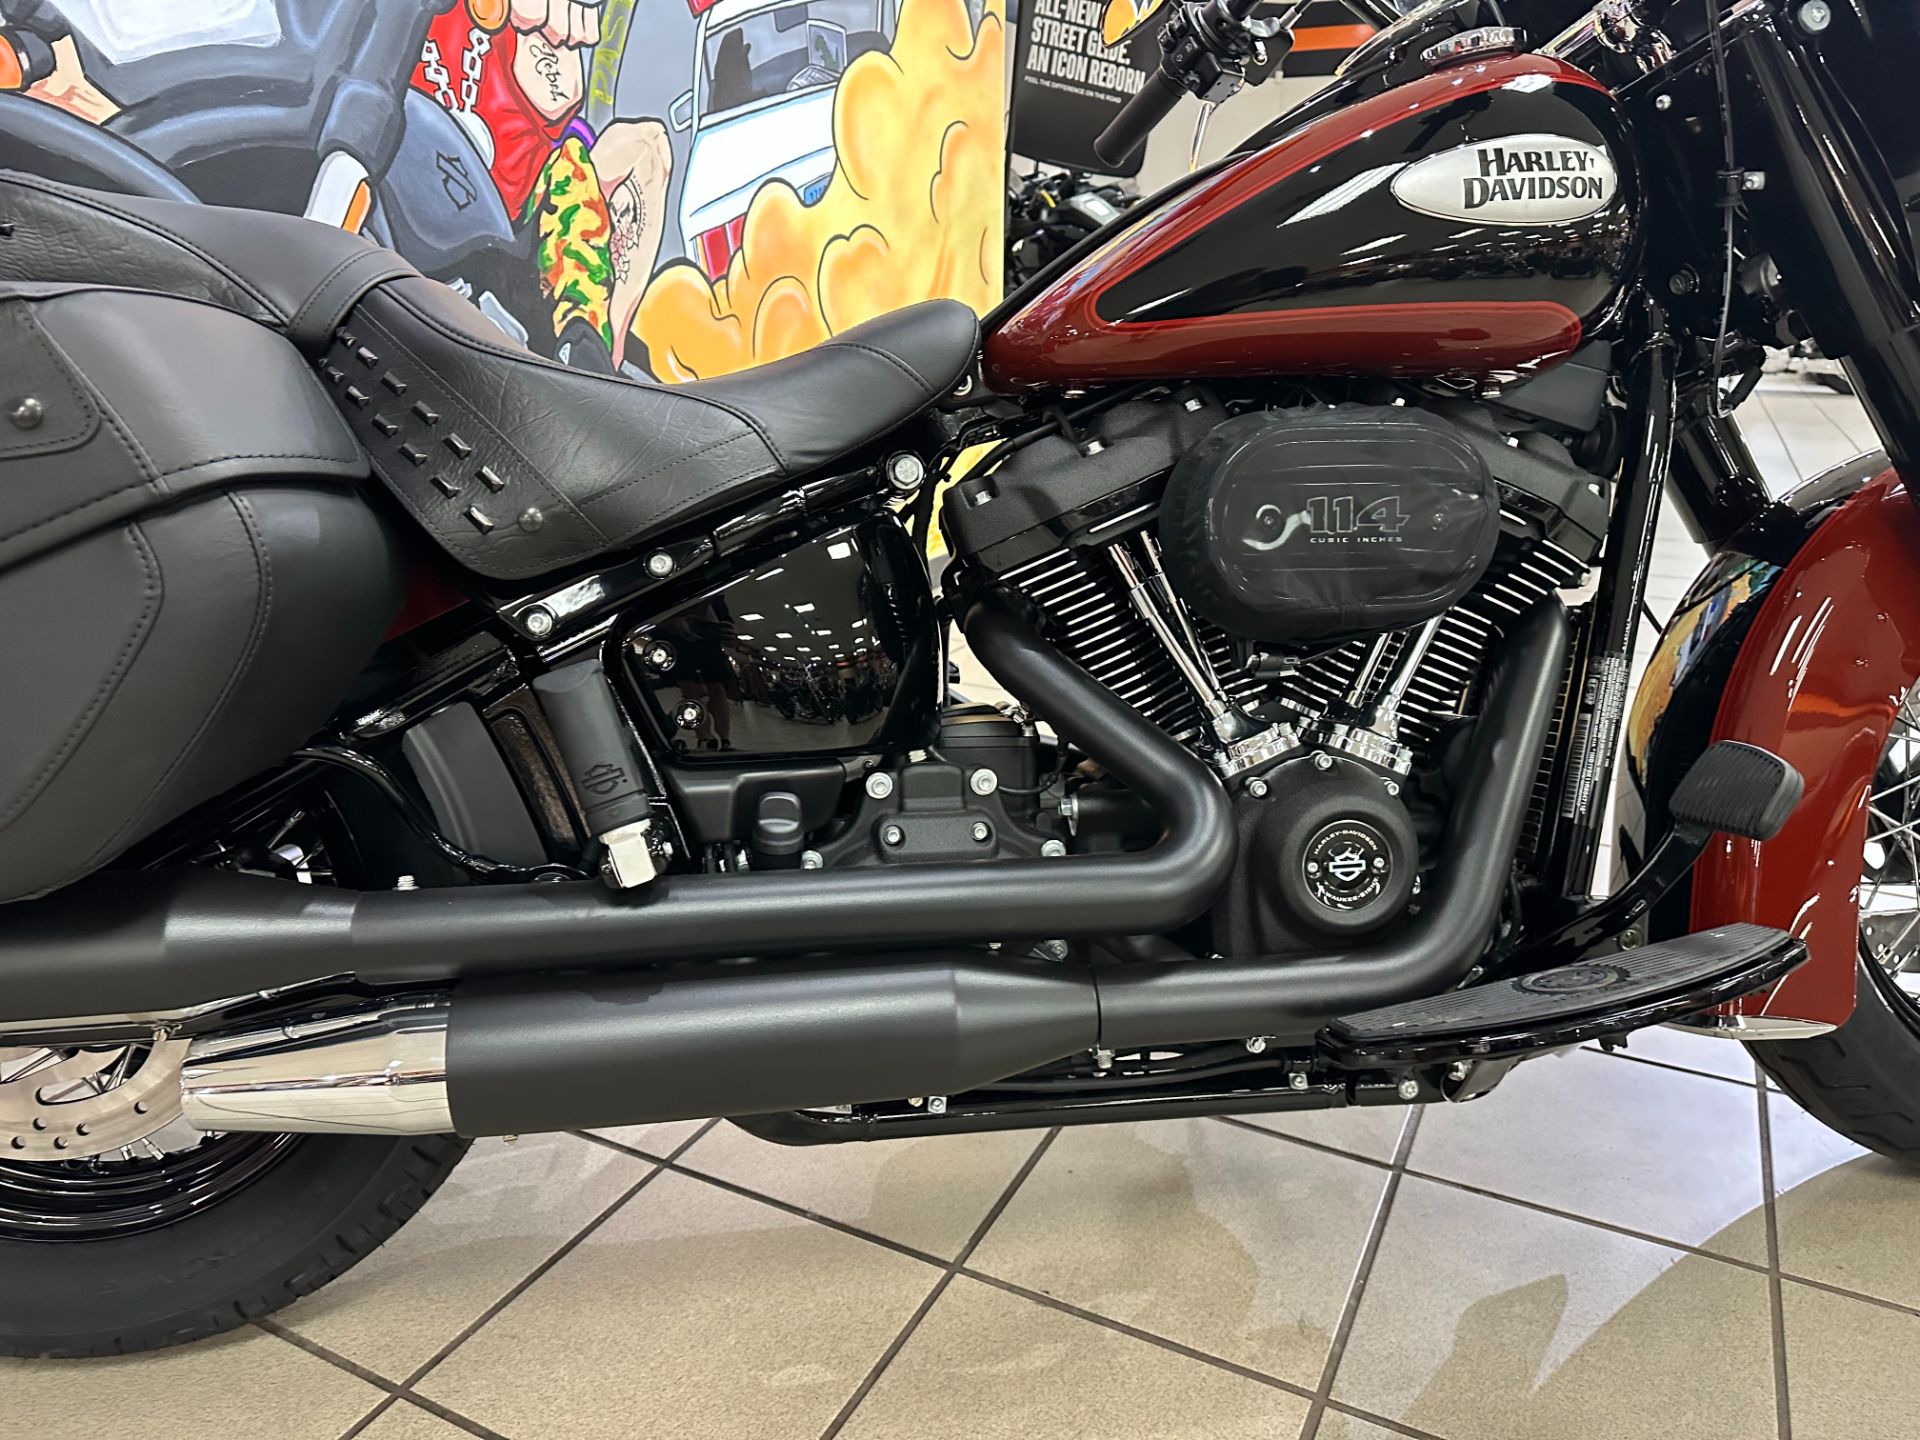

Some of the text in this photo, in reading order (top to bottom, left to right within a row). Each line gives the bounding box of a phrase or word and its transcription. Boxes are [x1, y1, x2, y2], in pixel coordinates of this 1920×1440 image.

[1034, 0, 1101, 28] ALL-NEW
[1031, 17, 1087, 52] STREET
[1026, 44, 1146, 95] AN ICON REBORN
[1040, 78, 1051, 88] THE
[1051, 81, 1085, 96] DIFFERENCE
[1094, 91, 1106, 101] THE
[1106, 94, 1122, 104] ROAD
[1463, 176, 1603, 209] DAVIDSON
[1306, 496, 1410, 534] 114
[1314, 829, 1378, 855] HARLEY-DAVIDSON
